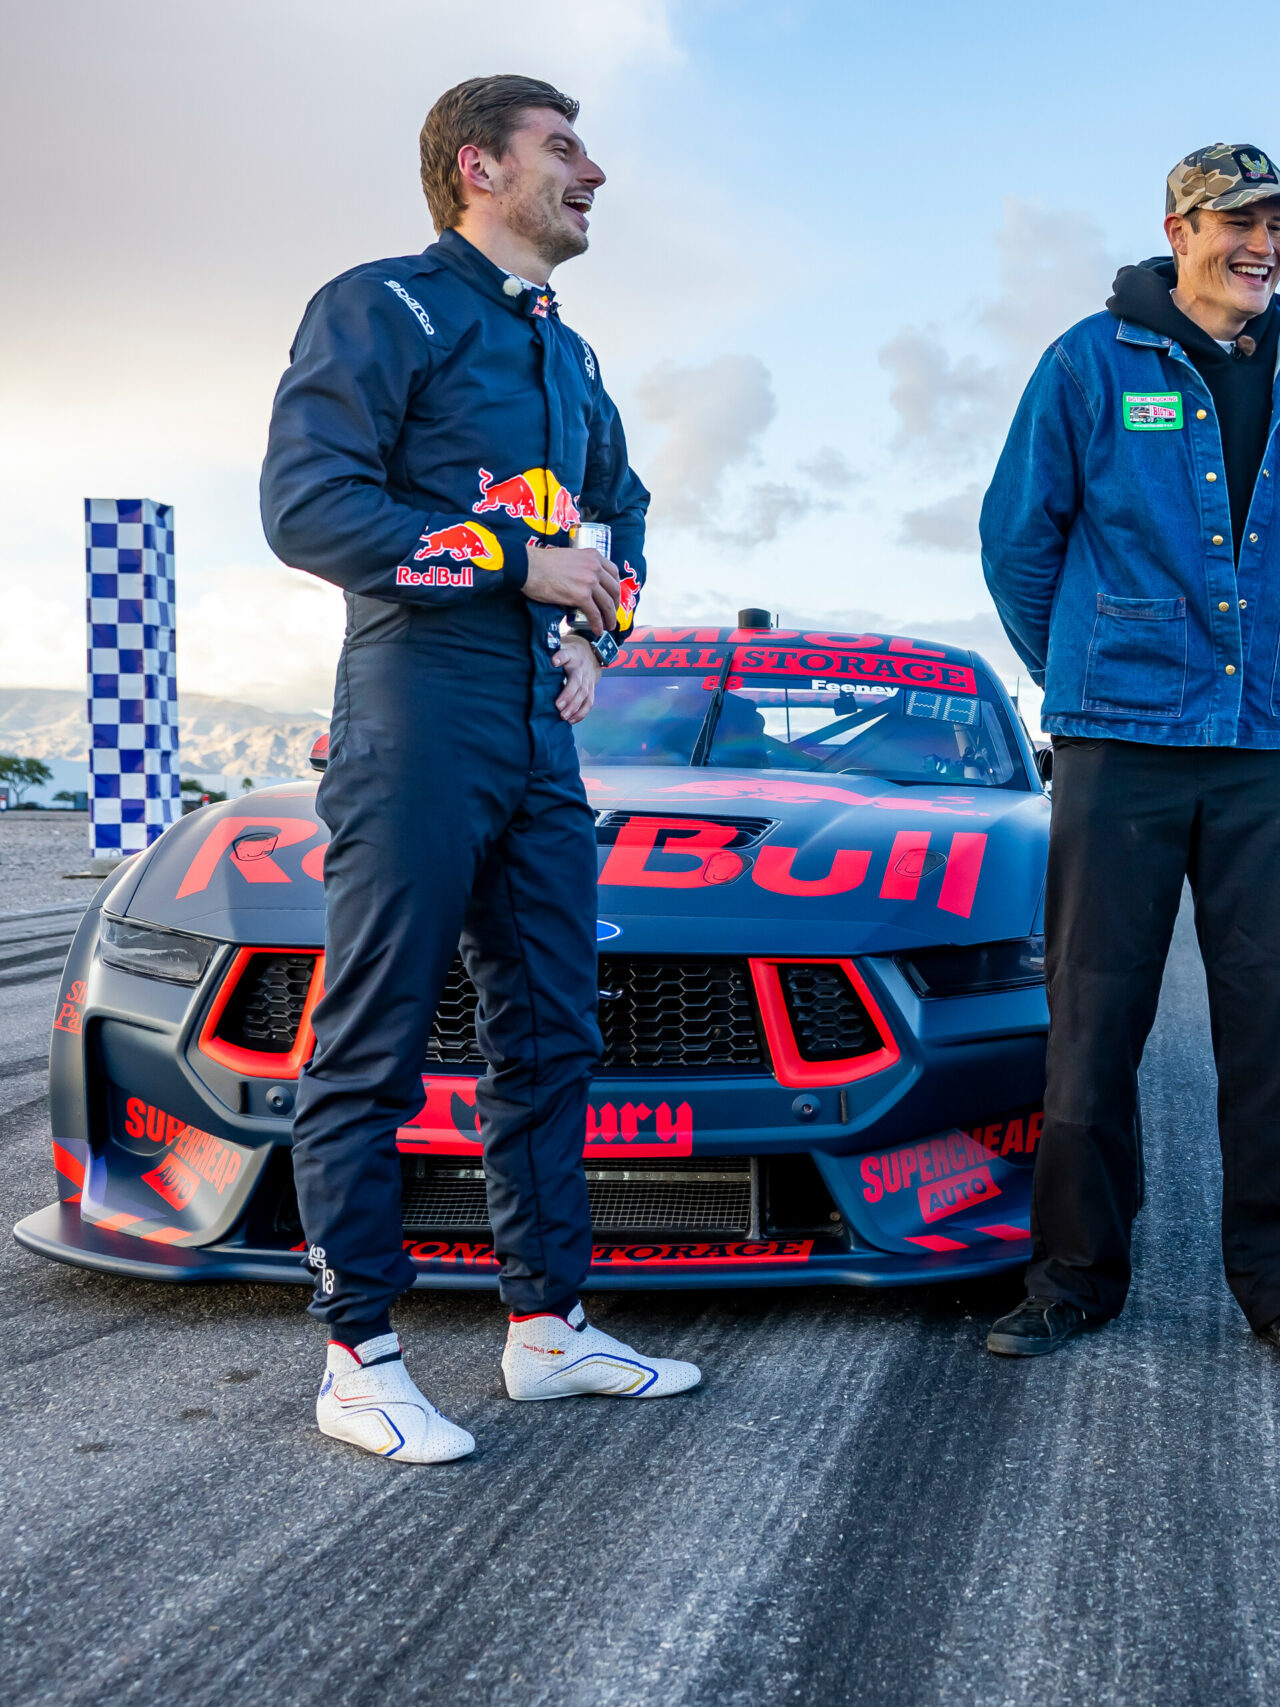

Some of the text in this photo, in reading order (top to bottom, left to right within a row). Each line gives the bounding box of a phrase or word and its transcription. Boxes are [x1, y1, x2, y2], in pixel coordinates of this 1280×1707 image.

[384, 280, 434, 335] sparco
[397, 566, 473, 587] Red Bull
[625, 628, 946, 658] MPOL
[603, 648, 967, 688] ONAL STORAGE
[811, 680, 900, 697] Feeney
[597, 815, 988, 918] Bull
[125, 1097, 242, 1195] SUPERCHEAP
[154, 1166, 192, 1200] AUTO
[929, 1178, 988, 1213] AUTO
[594, 1241, 804, 1262] TORAGE
